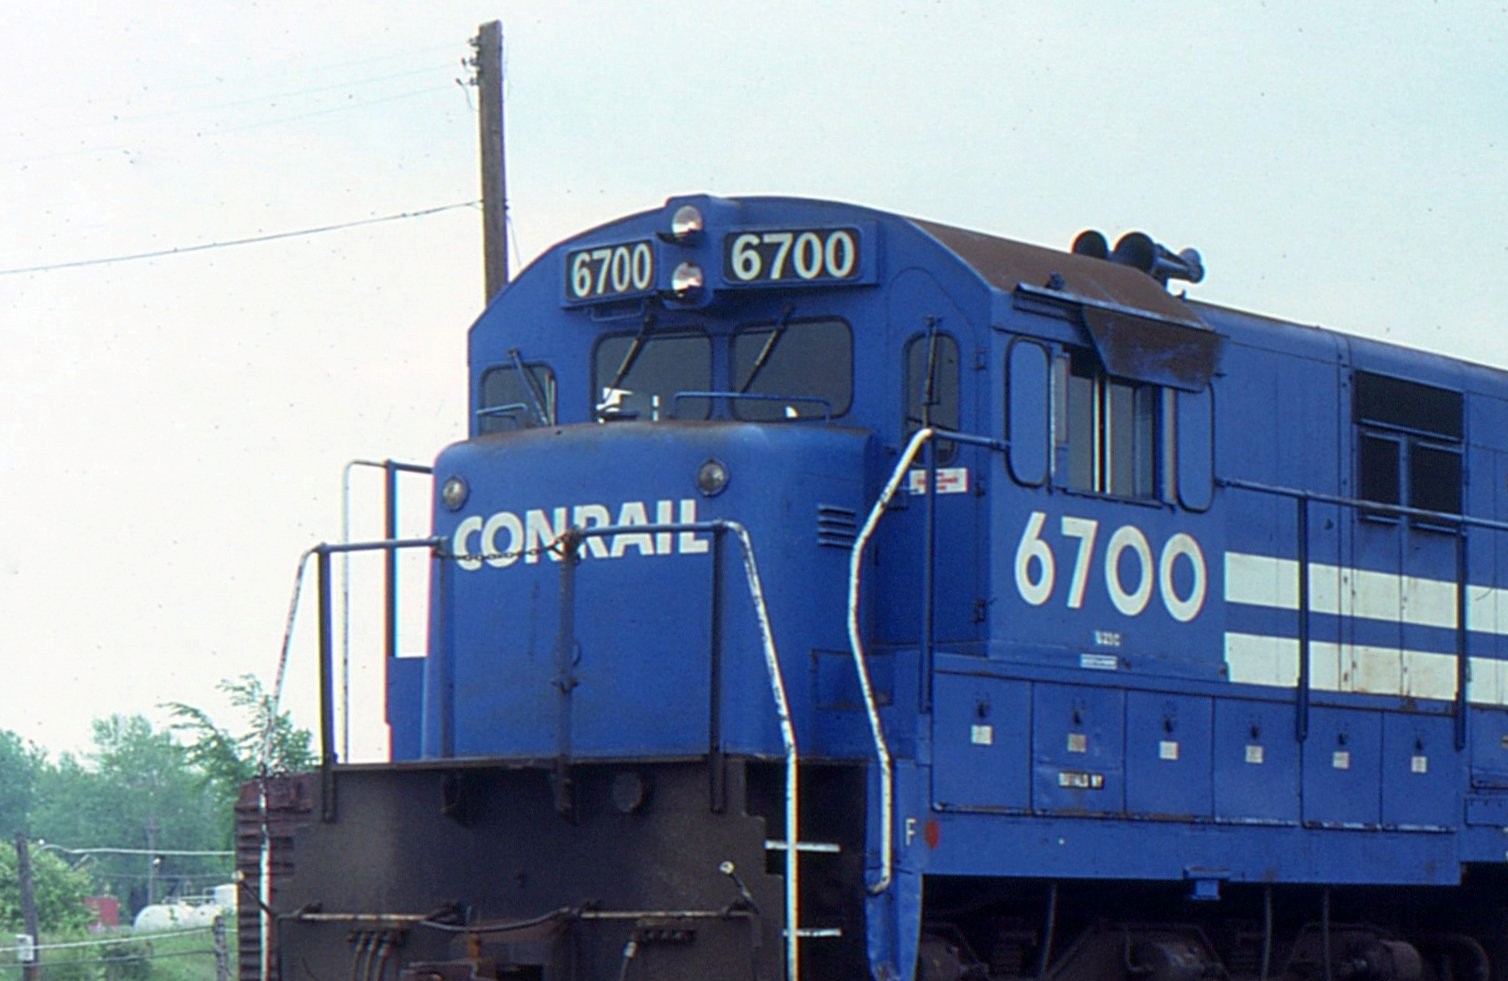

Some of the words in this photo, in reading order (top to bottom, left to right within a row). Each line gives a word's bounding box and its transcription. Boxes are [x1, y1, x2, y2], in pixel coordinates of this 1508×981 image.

[572, 243, 652, 298] 6700
[731, 231, 855, 281] 6700
[453, 499, 710, 571] CONRAIL
[1014, 511, 1206, 622] 6700
